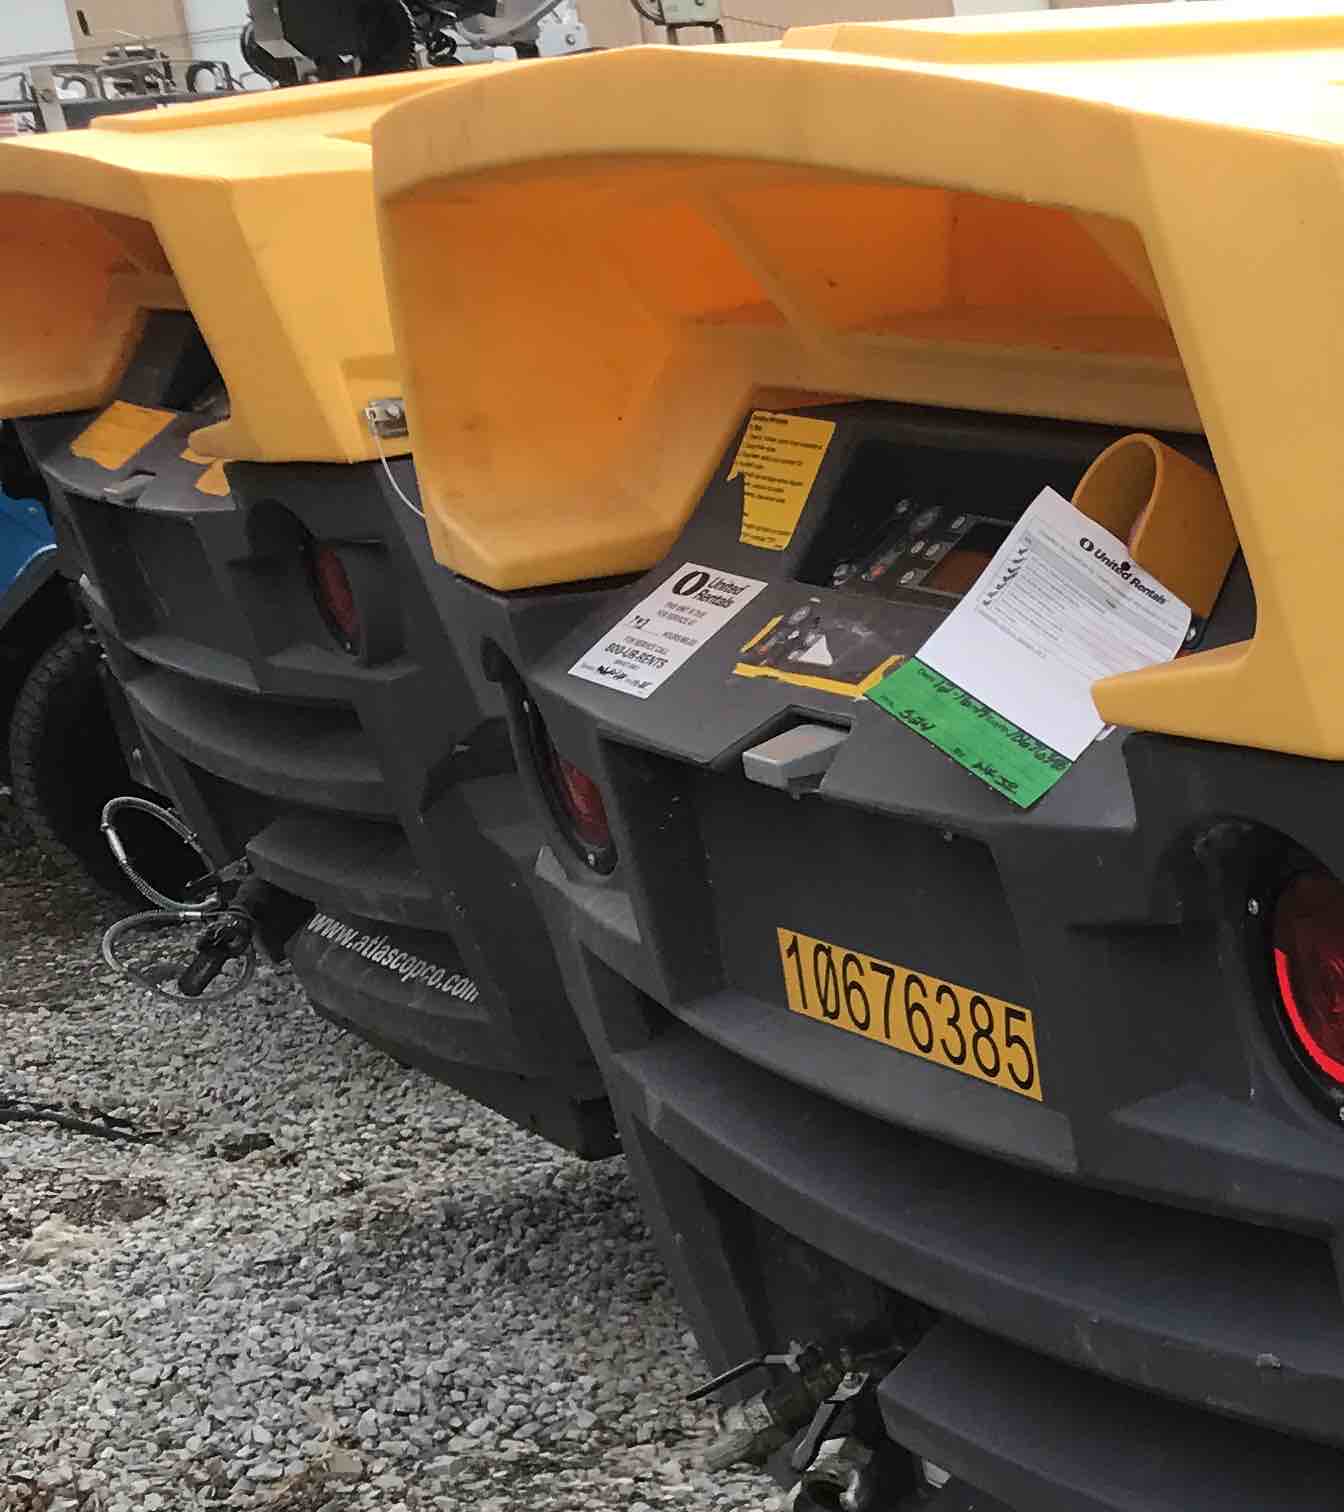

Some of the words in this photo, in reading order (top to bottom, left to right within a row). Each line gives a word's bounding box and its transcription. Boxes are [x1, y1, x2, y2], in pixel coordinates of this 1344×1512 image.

[693, 588, 736, 609] Rentals
[708, 576, 751, 596] United
[1094, 549, 1132, 580] United
[1129, 577, 1167, 605] Rentals
[307, 912, 480, 1003] www.atlascopco.com
[785, 934, 1034, 1091] 10676385
